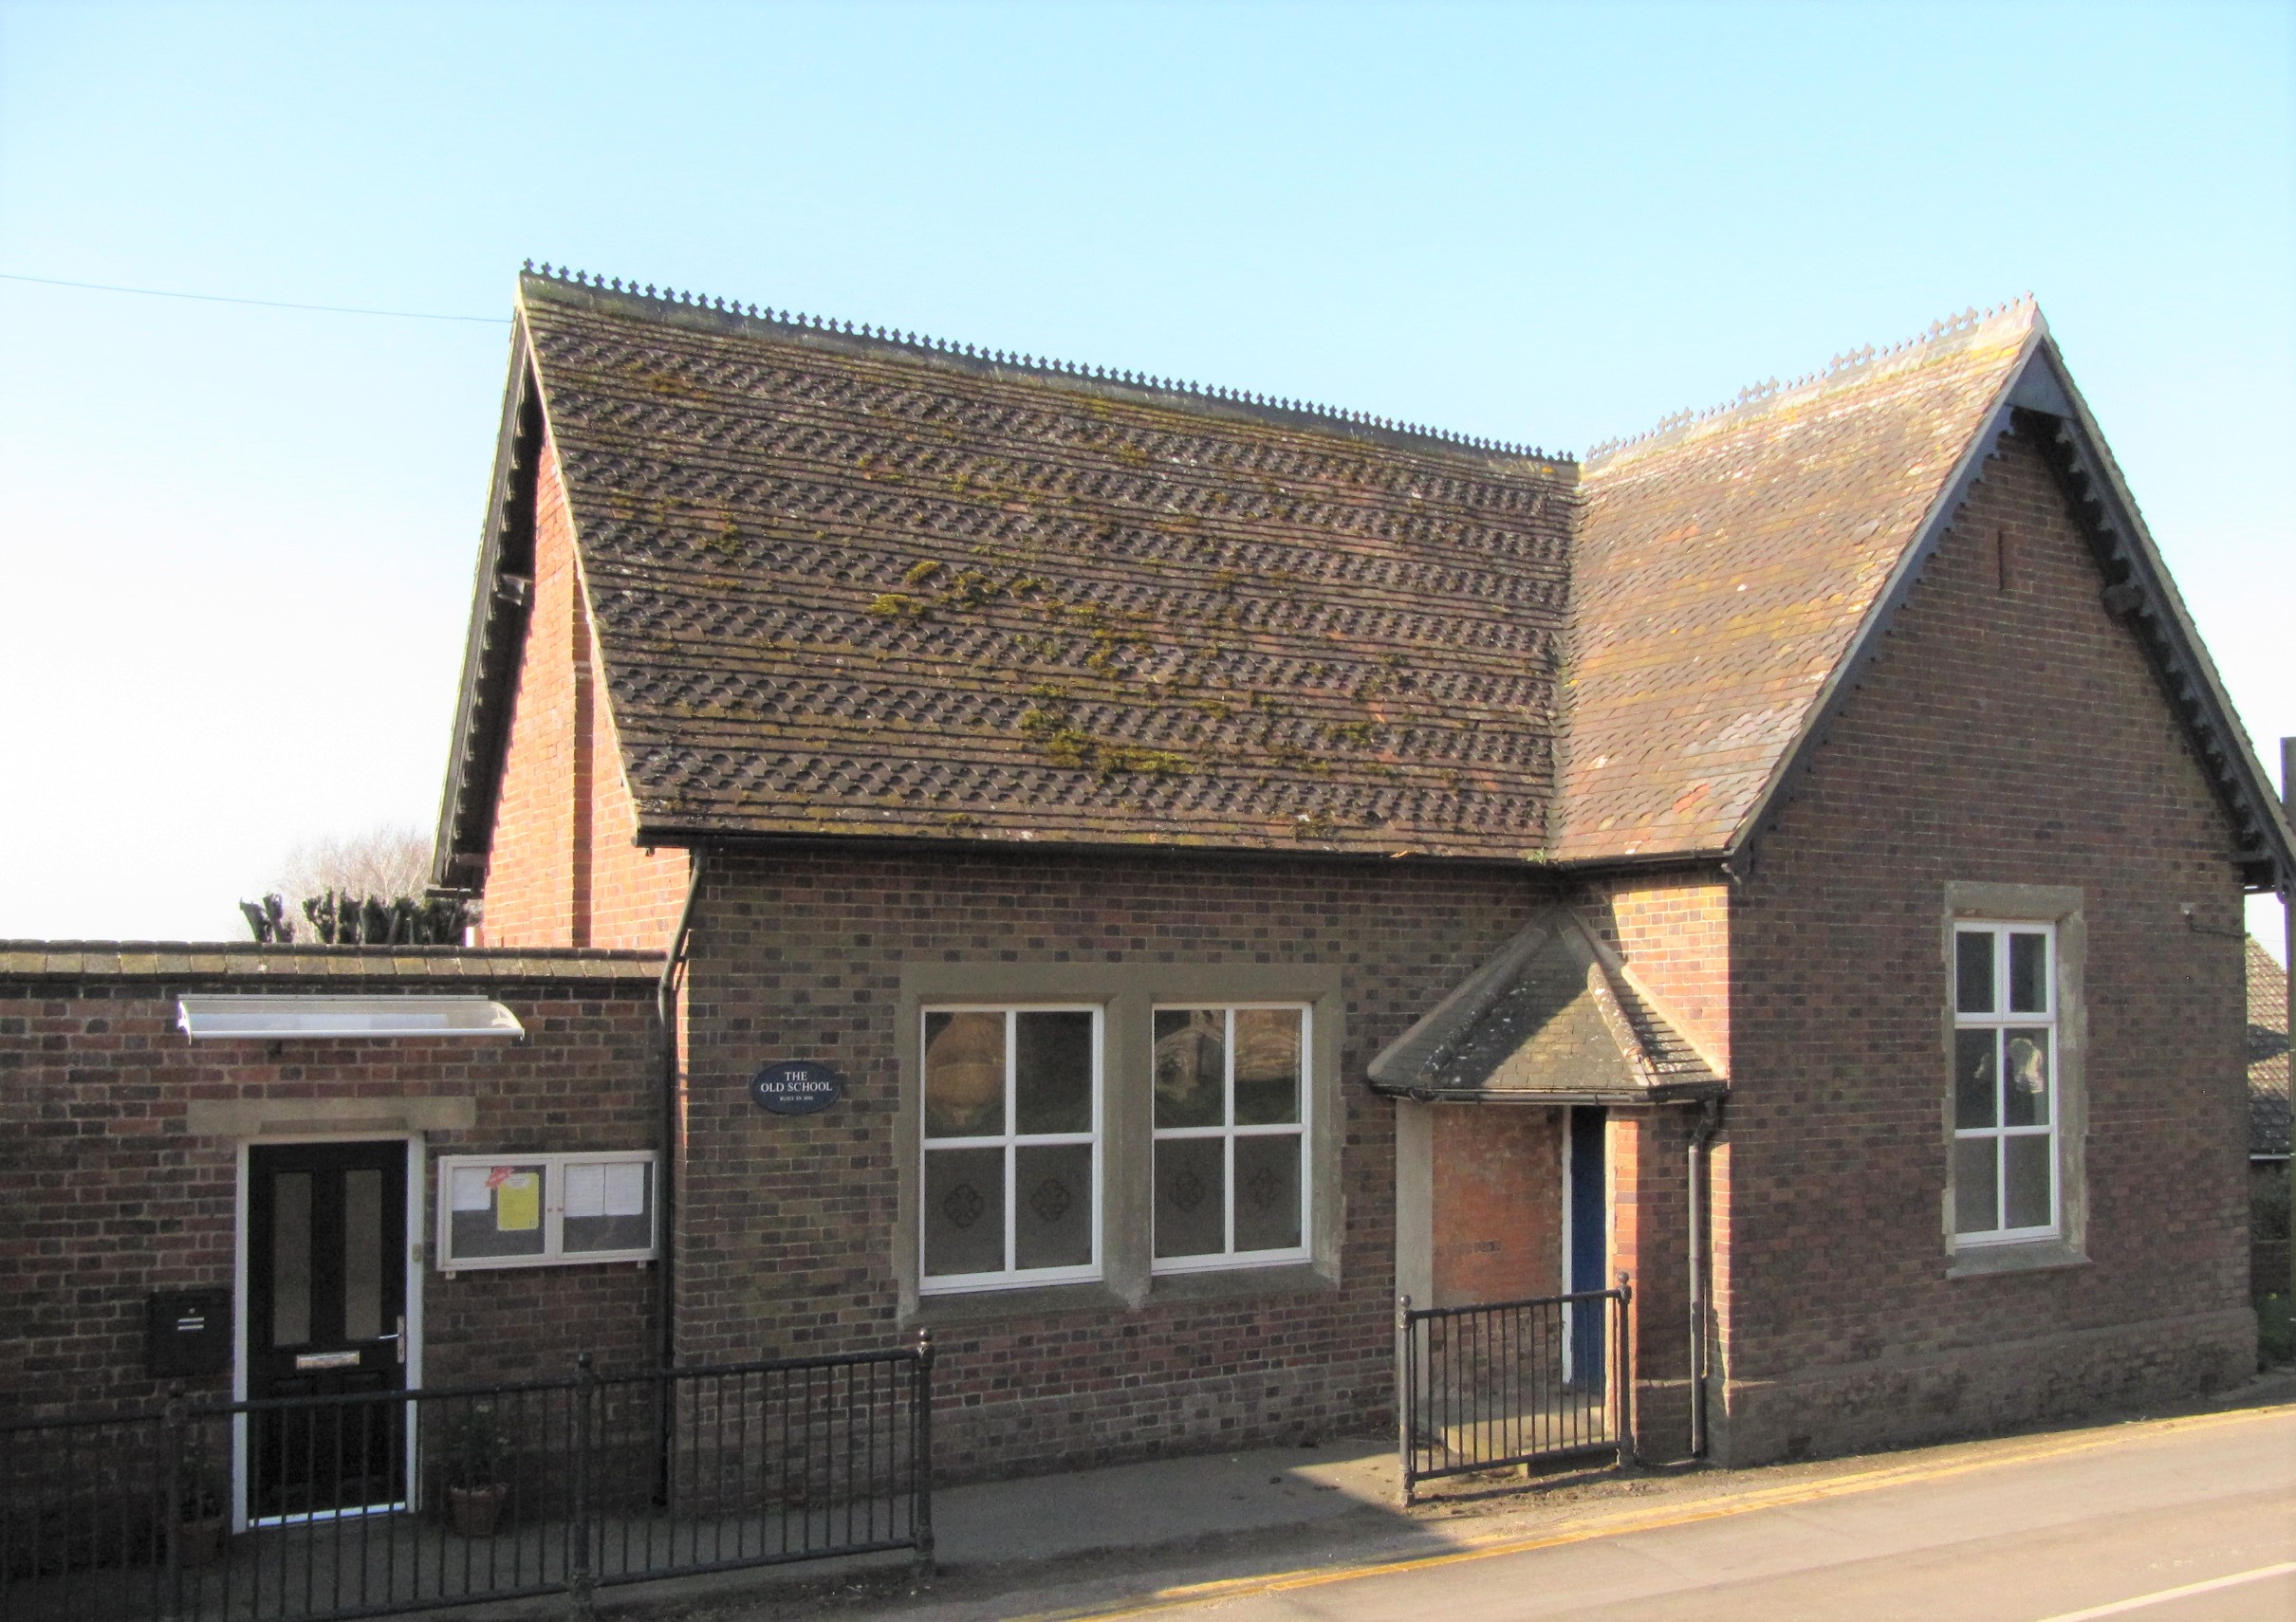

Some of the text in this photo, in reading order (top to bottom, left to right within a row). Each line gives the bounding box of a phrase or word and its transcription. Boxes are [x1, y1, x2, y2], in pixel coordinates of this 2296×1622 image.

[785, 1071, 807, 1081] THE
[760, 1081, 833, 1093] OLD SCHOOL
